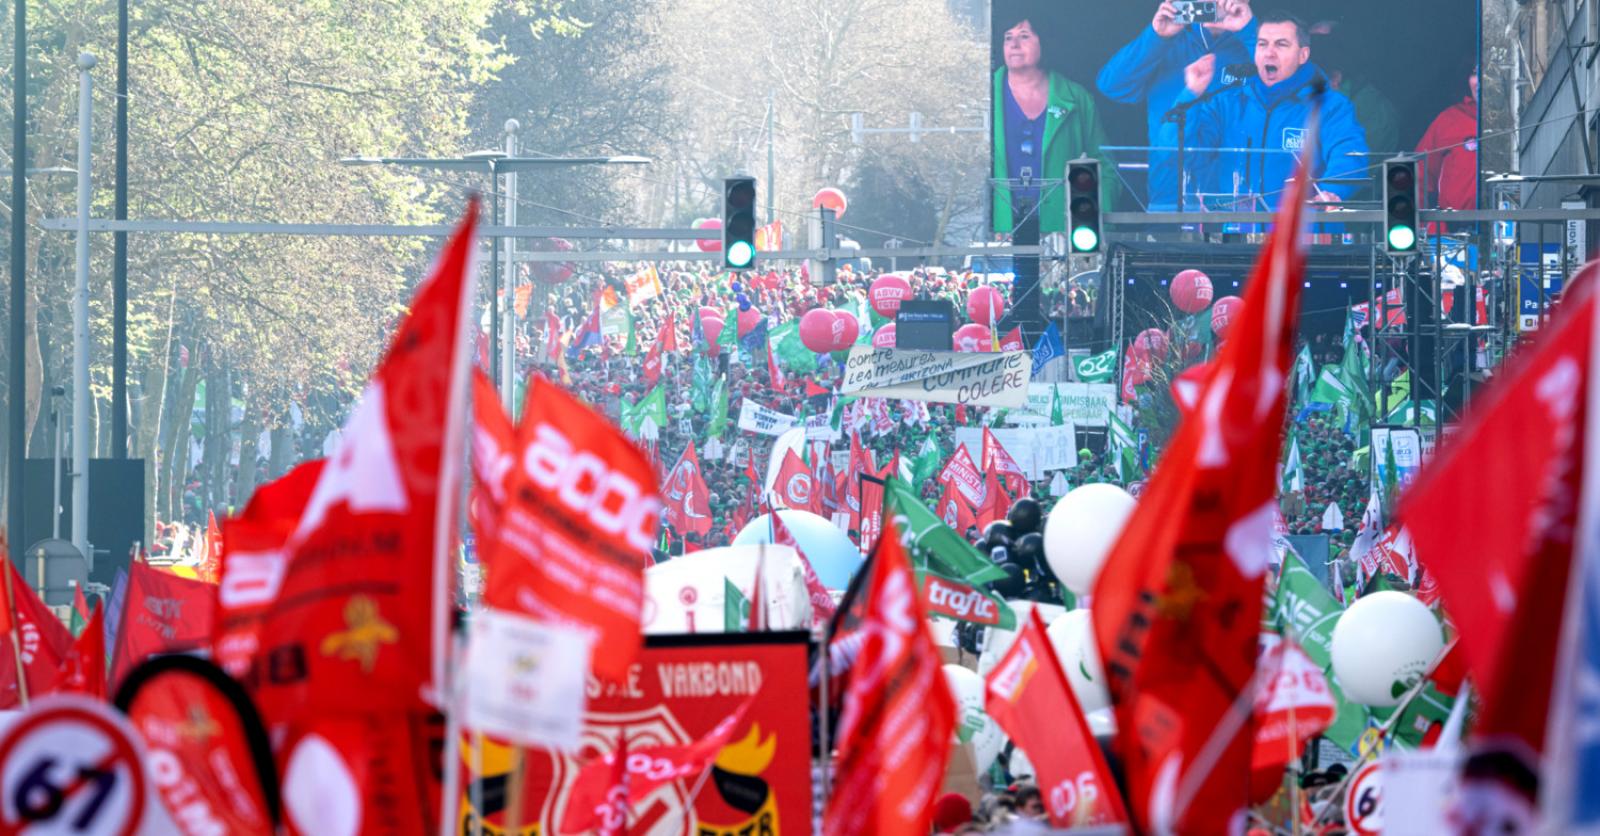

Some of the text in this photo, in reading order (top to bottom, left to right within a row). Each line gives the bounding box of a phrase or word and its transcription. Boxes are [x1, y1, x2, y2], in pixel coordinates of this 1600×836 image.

[848, 348, 893, 369] contre
[876, 352, 936, 377] mesures
[958, 369, 1024, 404] COLERE
[657, 661, 763, 699] VAKBOND
